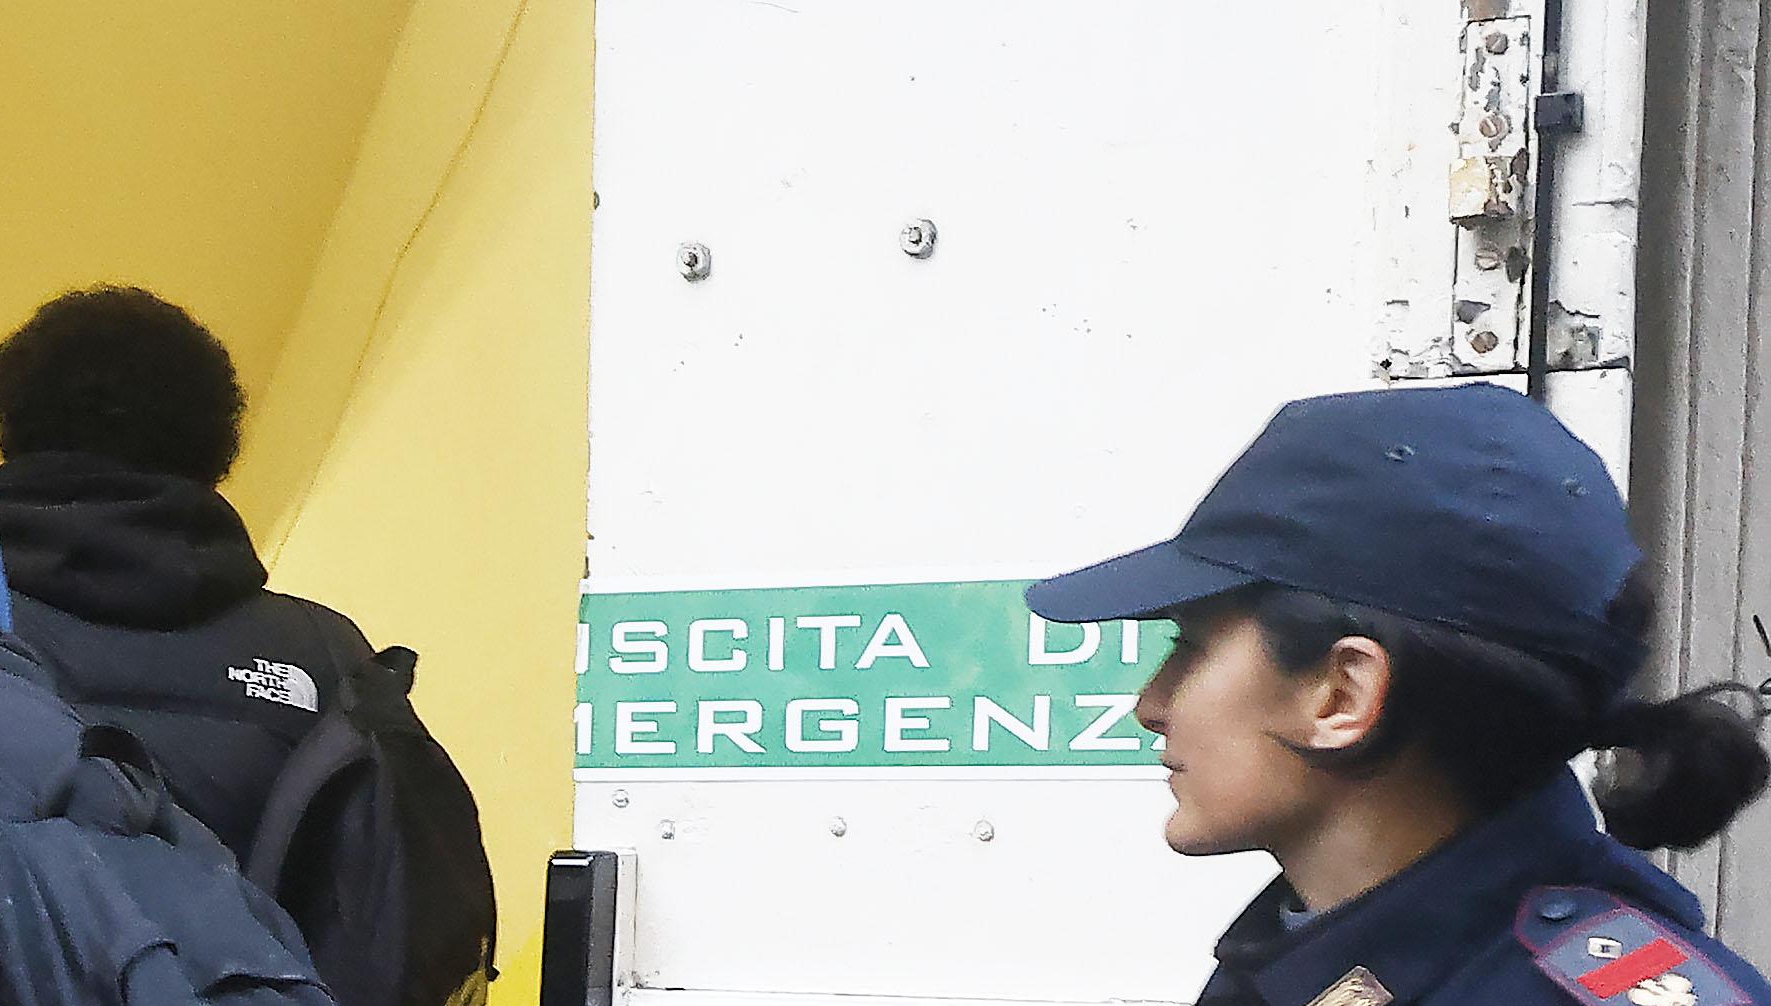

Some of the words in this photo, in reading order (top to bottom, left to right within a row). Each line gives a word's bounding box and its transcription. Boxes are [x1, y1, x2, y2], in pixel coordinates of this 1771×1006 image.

[1028, 610, 1141, 666] DI
[228, 666, 290, 690] NORTH
[252, 658, 290, 679] THE
[245, 683, 291, 703] FACE
[573, 693, 1168, 756] ERGENZ
